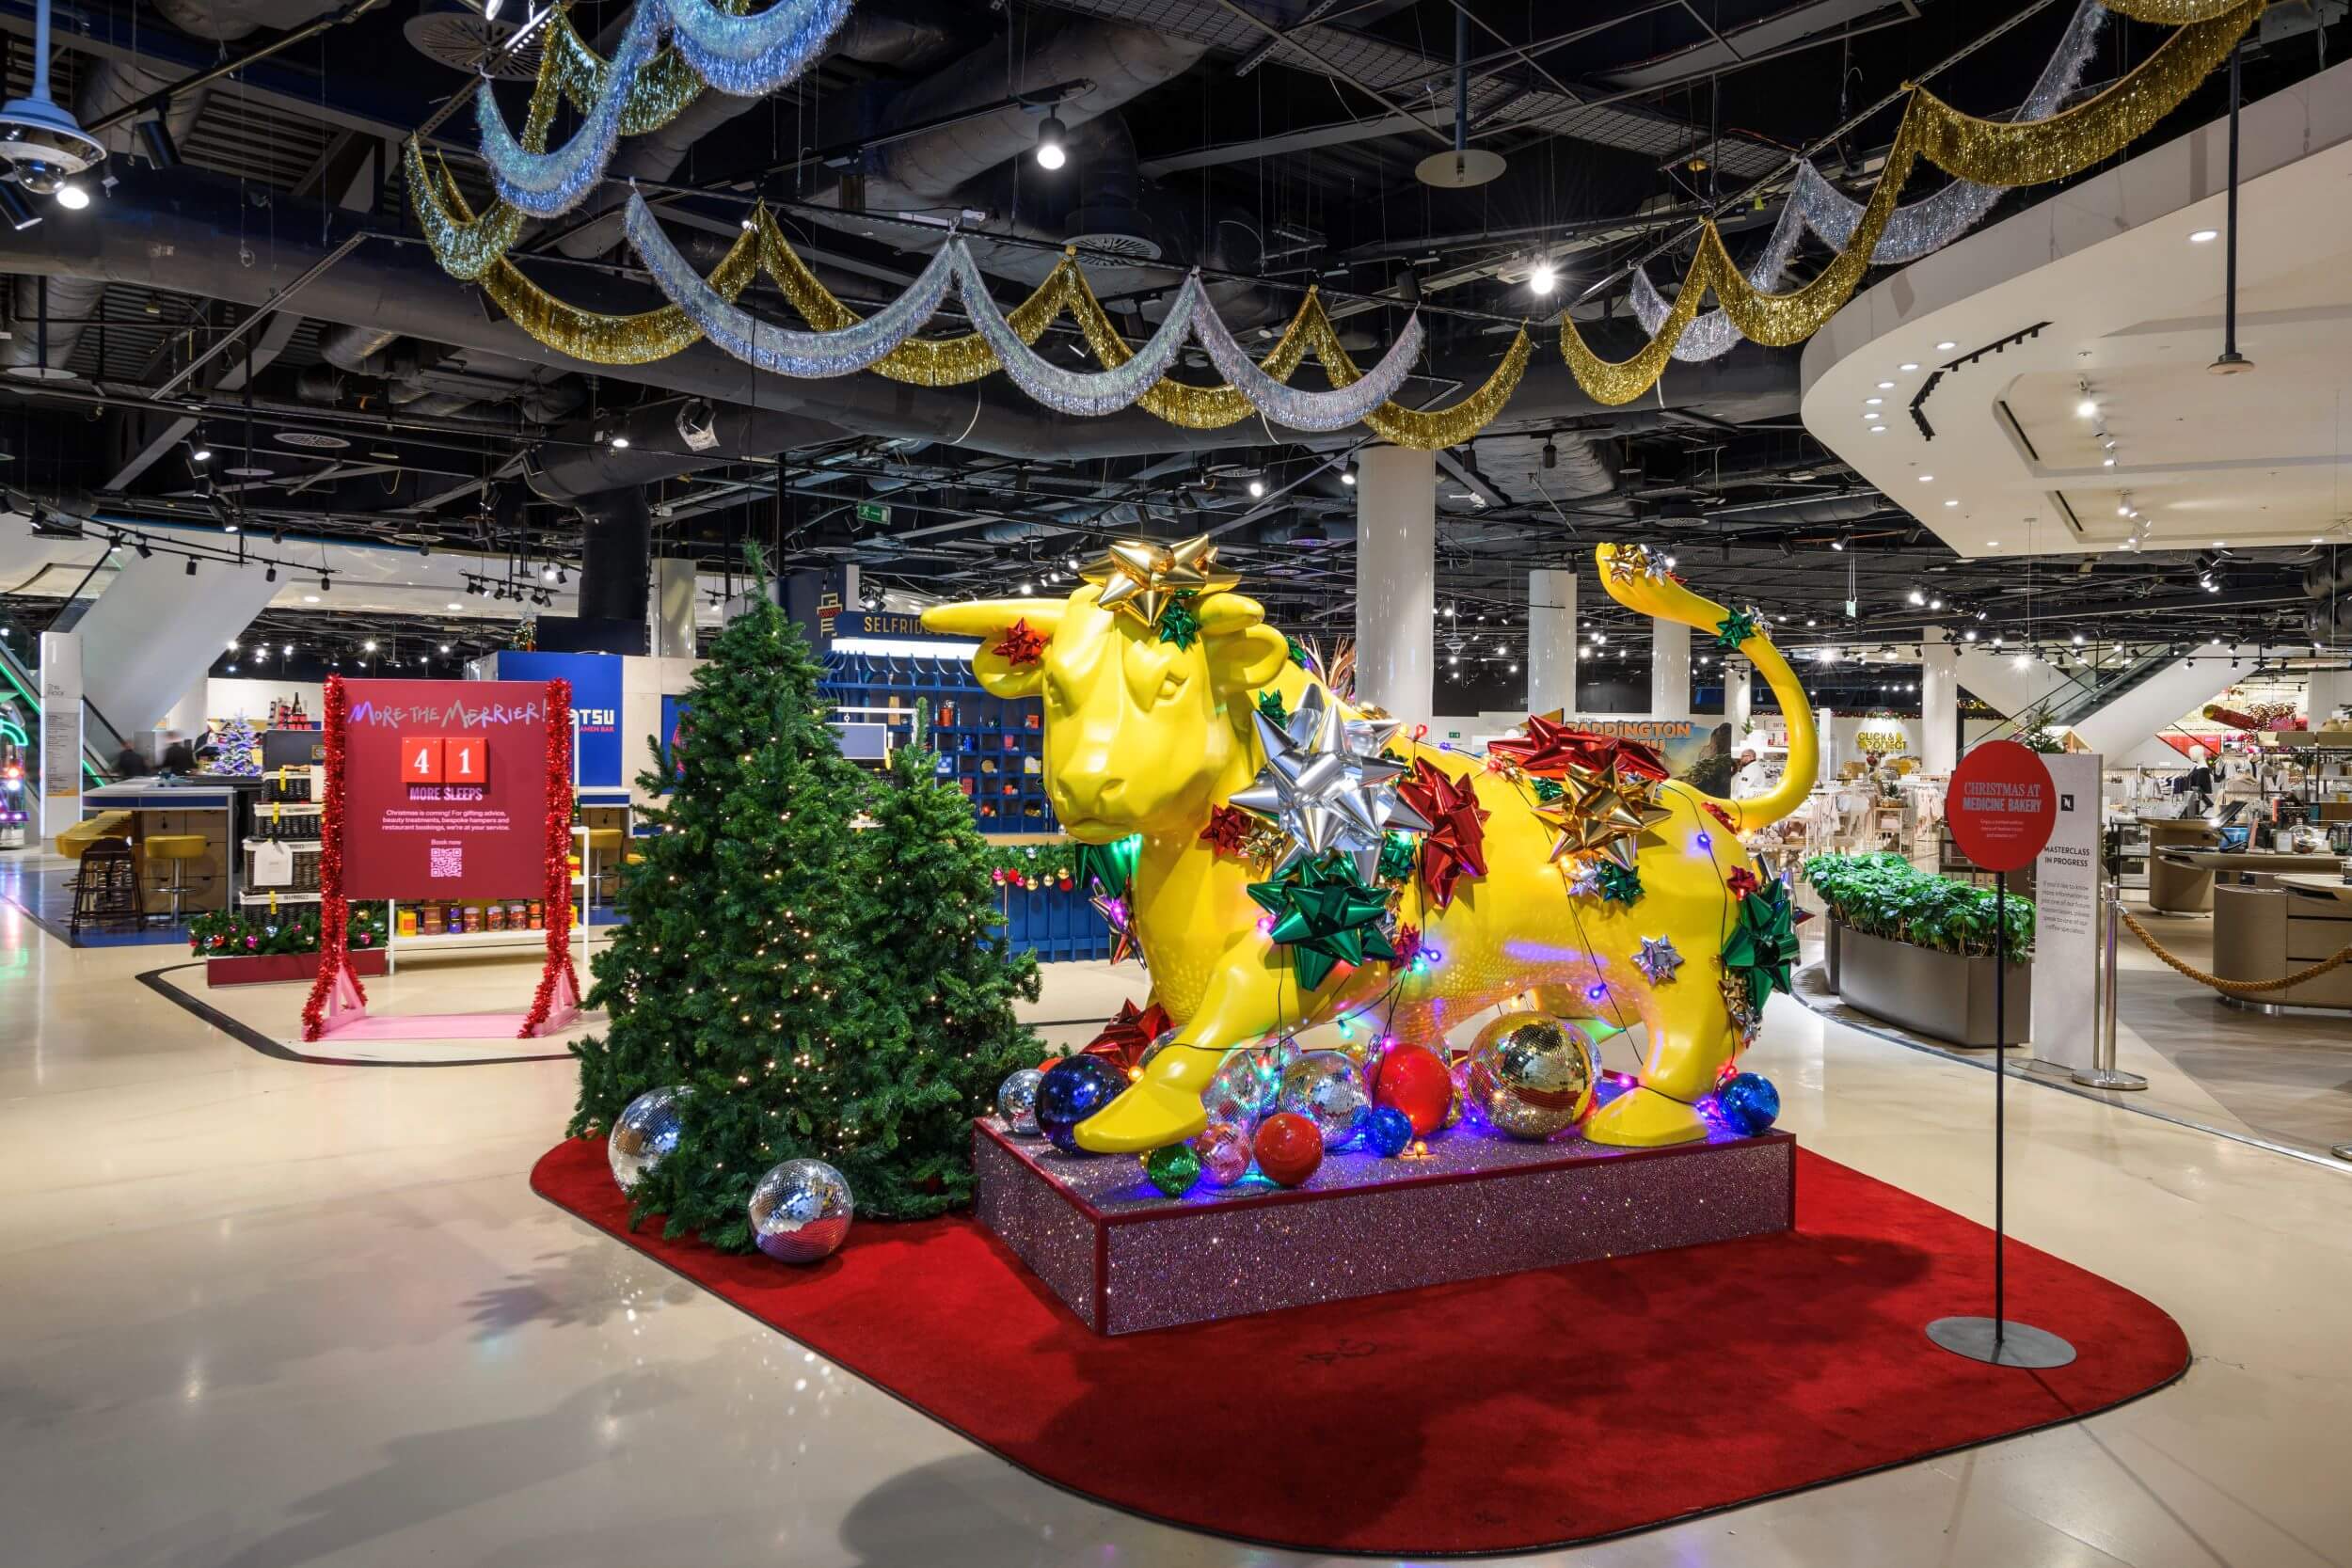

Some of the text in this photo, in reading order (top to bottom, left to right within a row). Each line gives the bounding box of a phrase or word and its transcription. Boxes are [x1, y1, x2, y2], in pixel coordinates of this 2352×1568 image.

[864, 616, 949, 635] SELFRID
[414, 748, 471, 774] 4 1
[409, 786, 484, 800] MORE SLEEPS
[1964, 782, 2041, 798] CHRISTMAS AT
[1963, 797, 2042, 813] MEDICINE BAKERY
[2044, 846, 2090, 857] MASTERCLASS
[2053, 857, 2088, 867] PROGRESS
